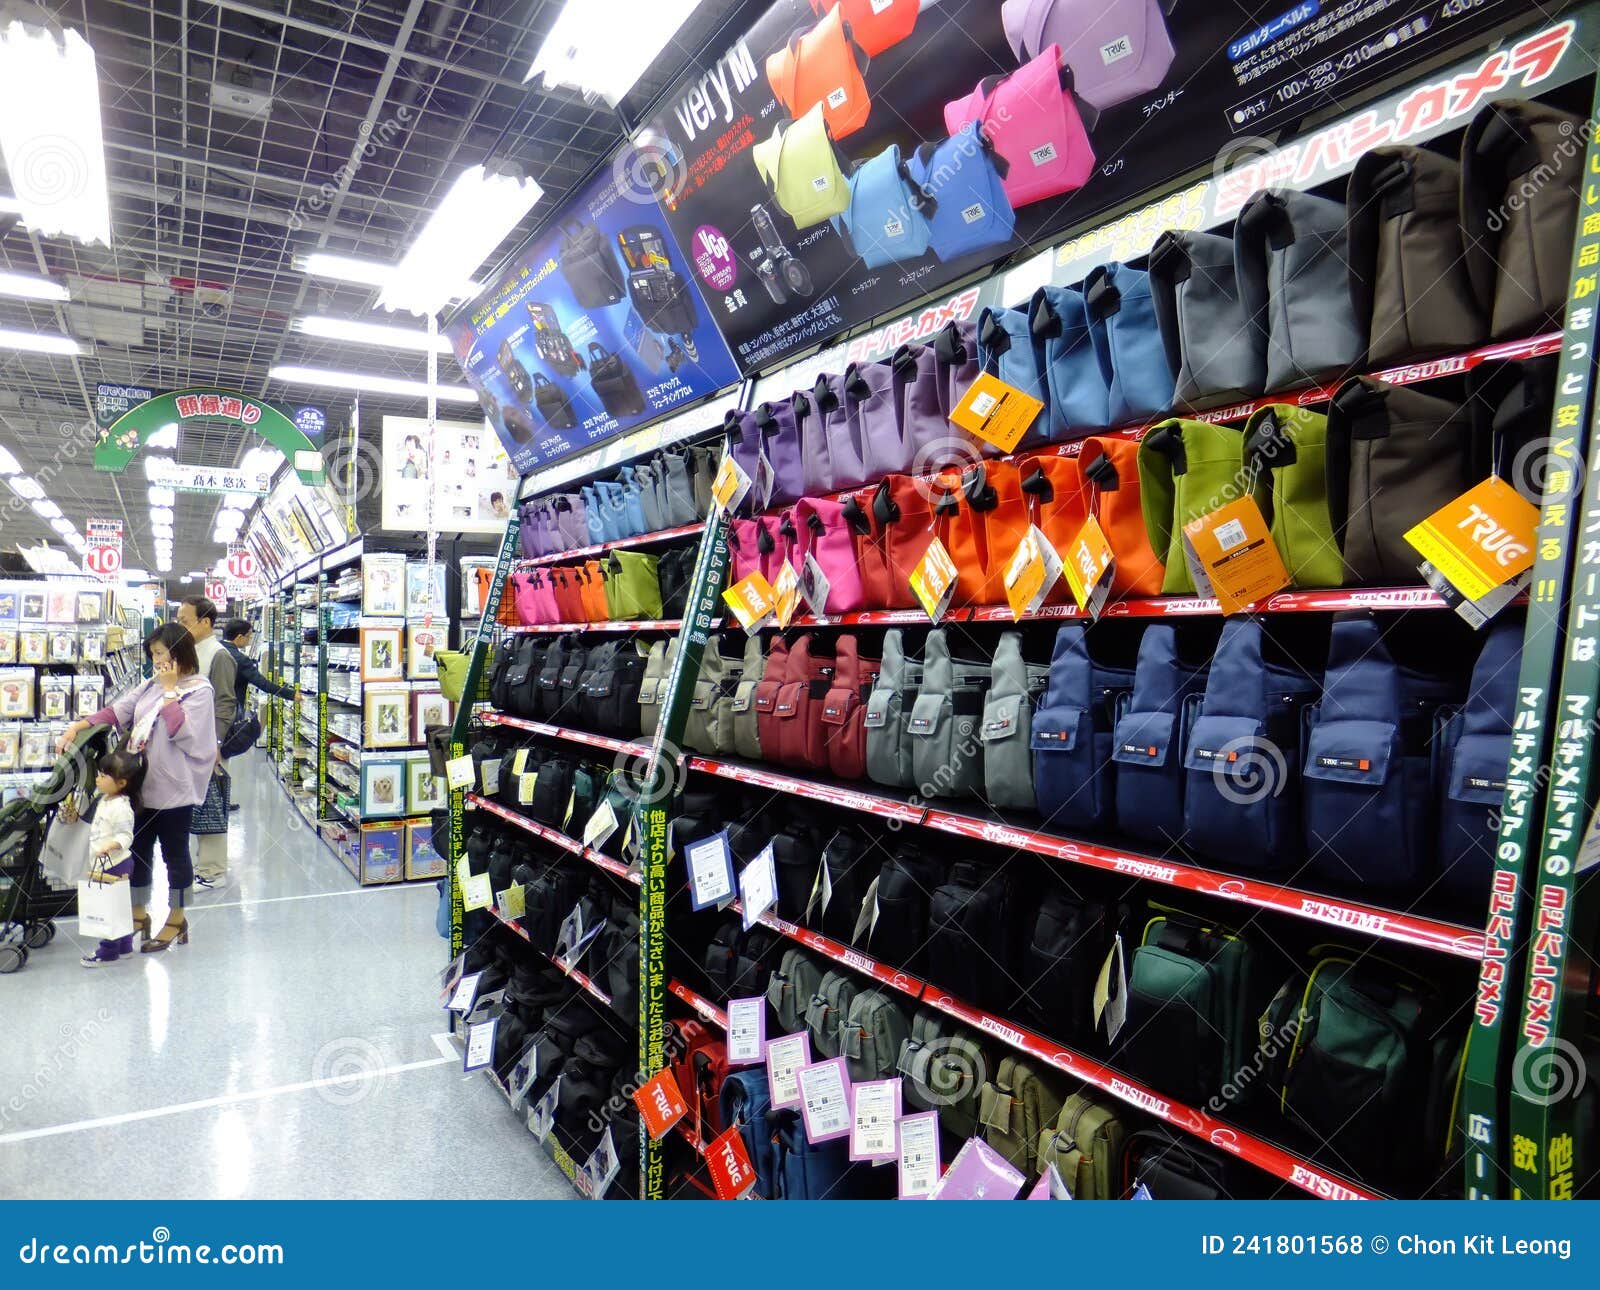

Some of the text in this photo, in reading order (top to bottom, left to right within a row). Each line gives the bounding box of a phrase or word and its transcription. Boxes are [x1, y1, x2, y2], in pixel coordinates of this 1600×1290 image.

[1231, 3, 1312, 58] ショルダーベルト
[674, 33, 759, 142] very M
[1142, 89, 1185, 117] ラベンダー
[844, 286, 981, 364] ヨドバシカメラ
[175, 394, 262, 424] 額縁通り
[1456, 503, 1528, 567] TRUE
[90, 548, 118, 572] 10
[229, 554, 255, 576] 10
[207, 583, 225, 598] 10
[1113, 857, 1178, 884] ETSUMI
[1300, 899, 1389, 934] ETSUMI
[651, 1082, 673, 1121] TRUE
[1109, 1077, 1172, 1118] ETSUMI
[721, 1140, 743, 1187] TRUE
